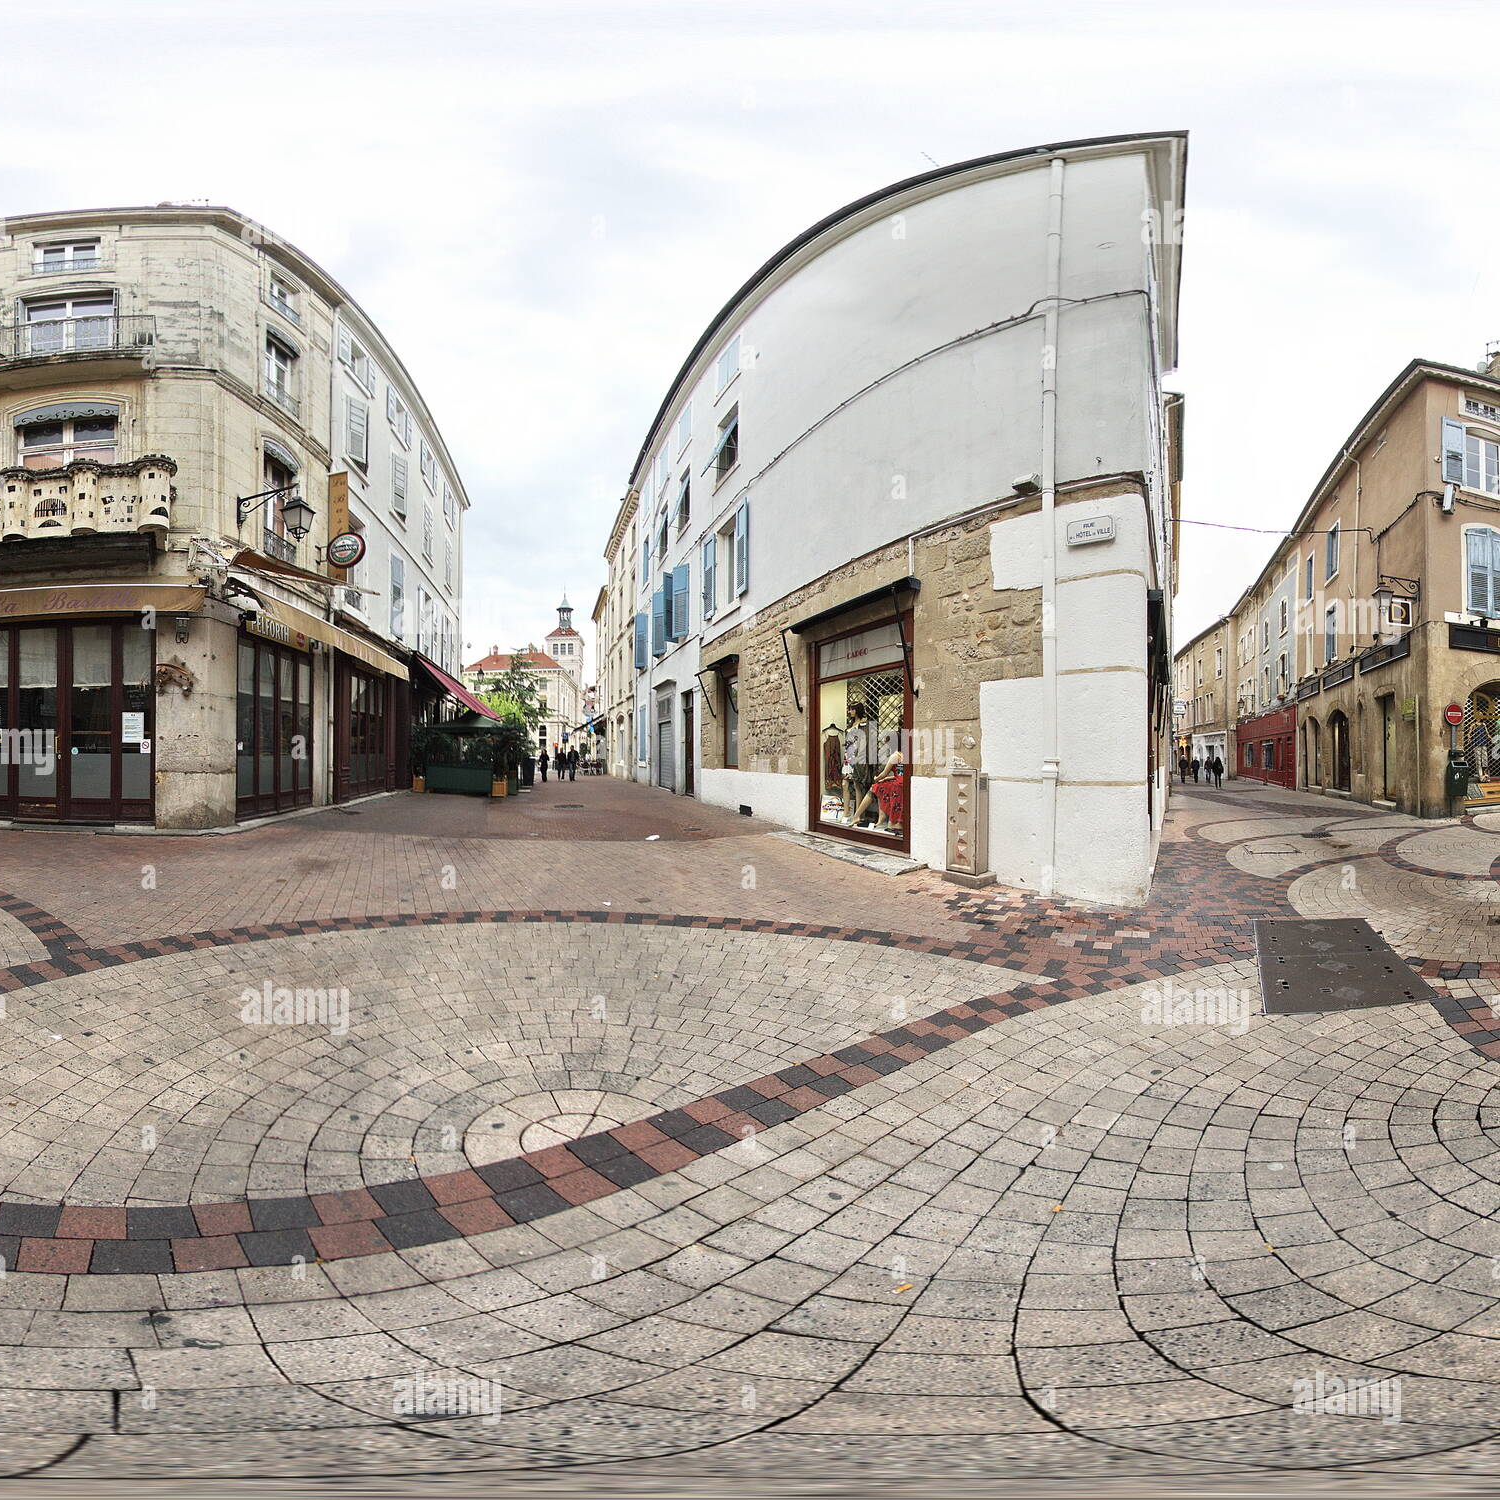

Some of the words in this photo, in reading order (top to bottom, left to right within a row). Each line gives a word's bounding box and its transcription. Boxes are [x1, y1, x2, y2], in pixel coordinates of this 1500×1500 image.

[1097, 527, 1111, 536] VILLE
[42, 589, 141, 611] Bastille
[251, 613, 291, 644] PELFORTH
[846, 648, 869, 660] CARGO
